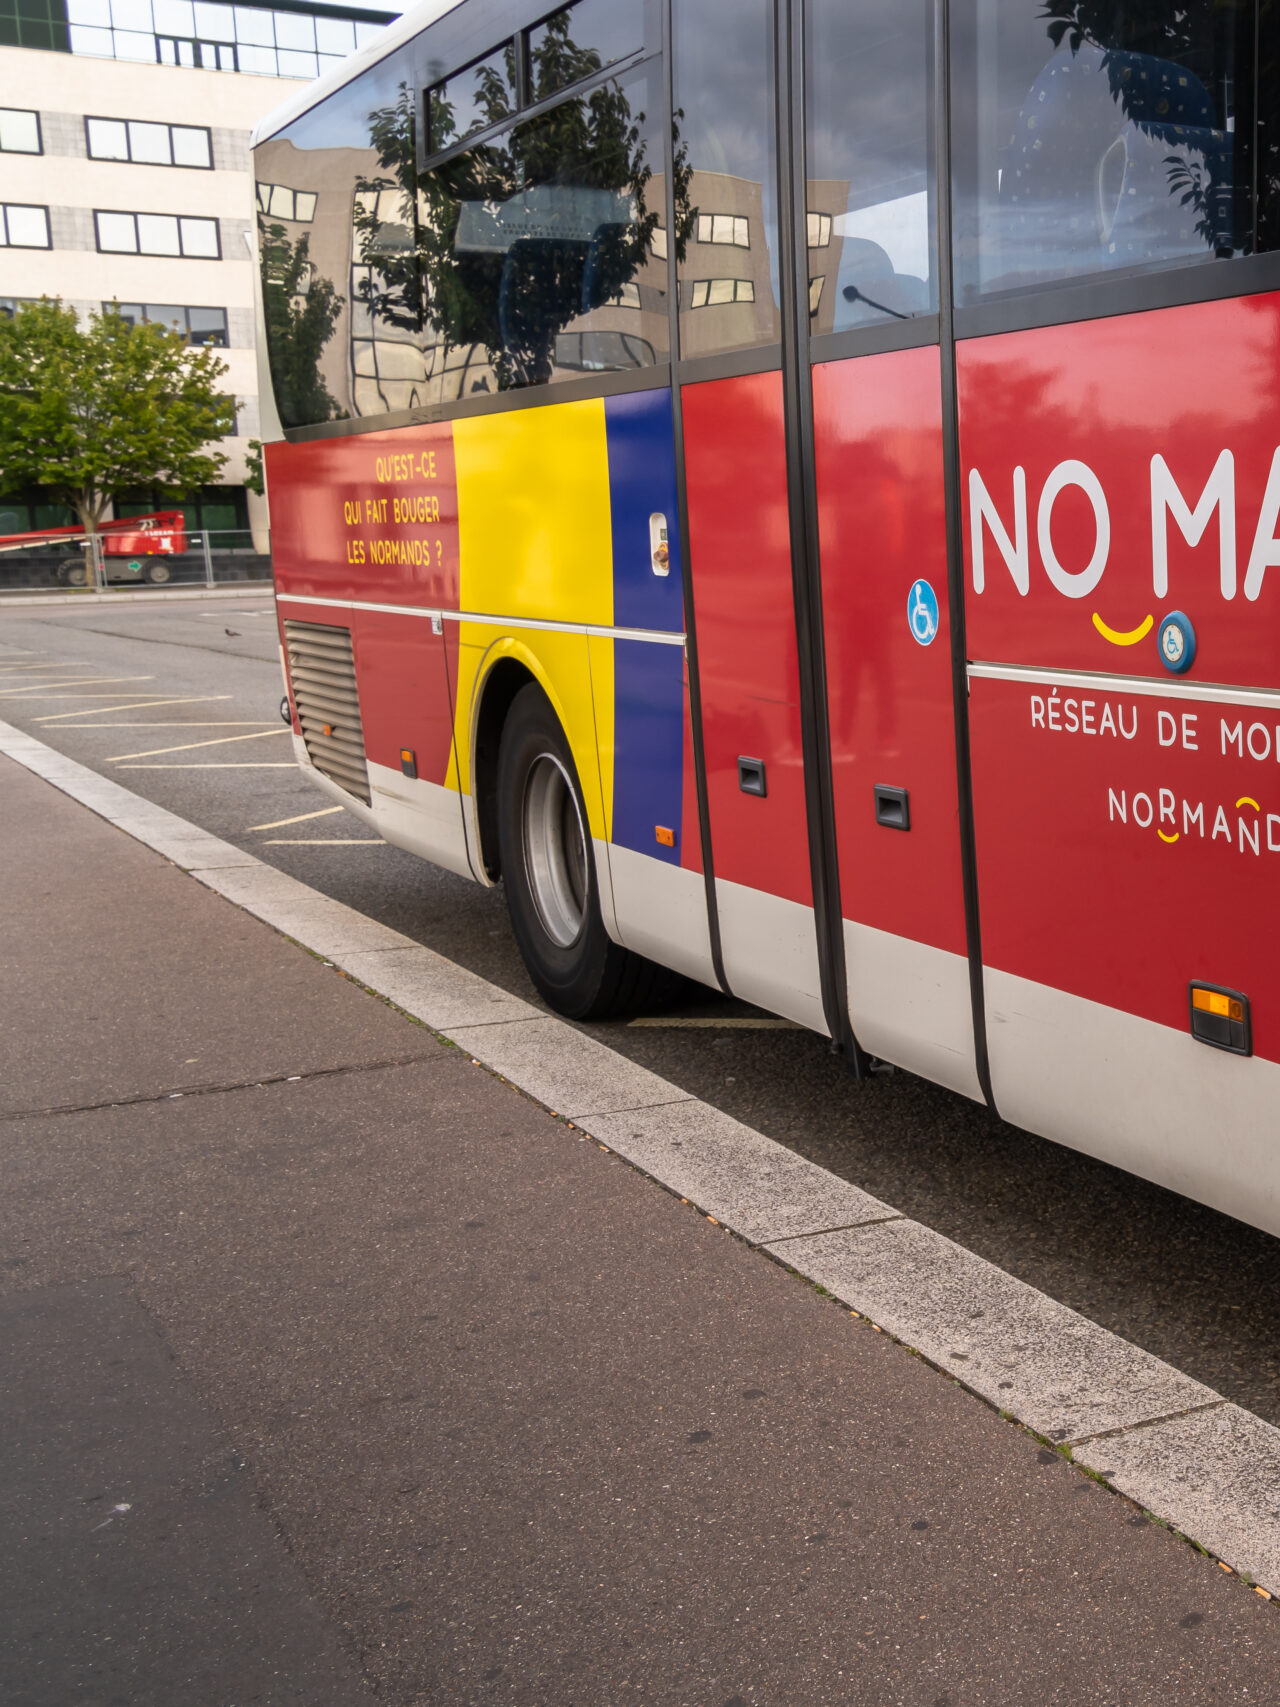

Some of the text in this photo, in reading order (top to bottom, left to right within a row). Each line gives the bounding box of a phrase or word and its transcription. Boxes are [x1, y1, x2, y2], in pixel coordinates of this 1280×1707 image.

[376, 451, 437, 483] QU'EST-CE
[344, 495, 440, 525] QUI FAIT BOUGER
[346, 539, 366, 565] LES
[370, 539, 430, 567] NORMANDS
[1030, 687, 1138, 740] RÉSEAU
[1157, 710, 1199, 751] DE
